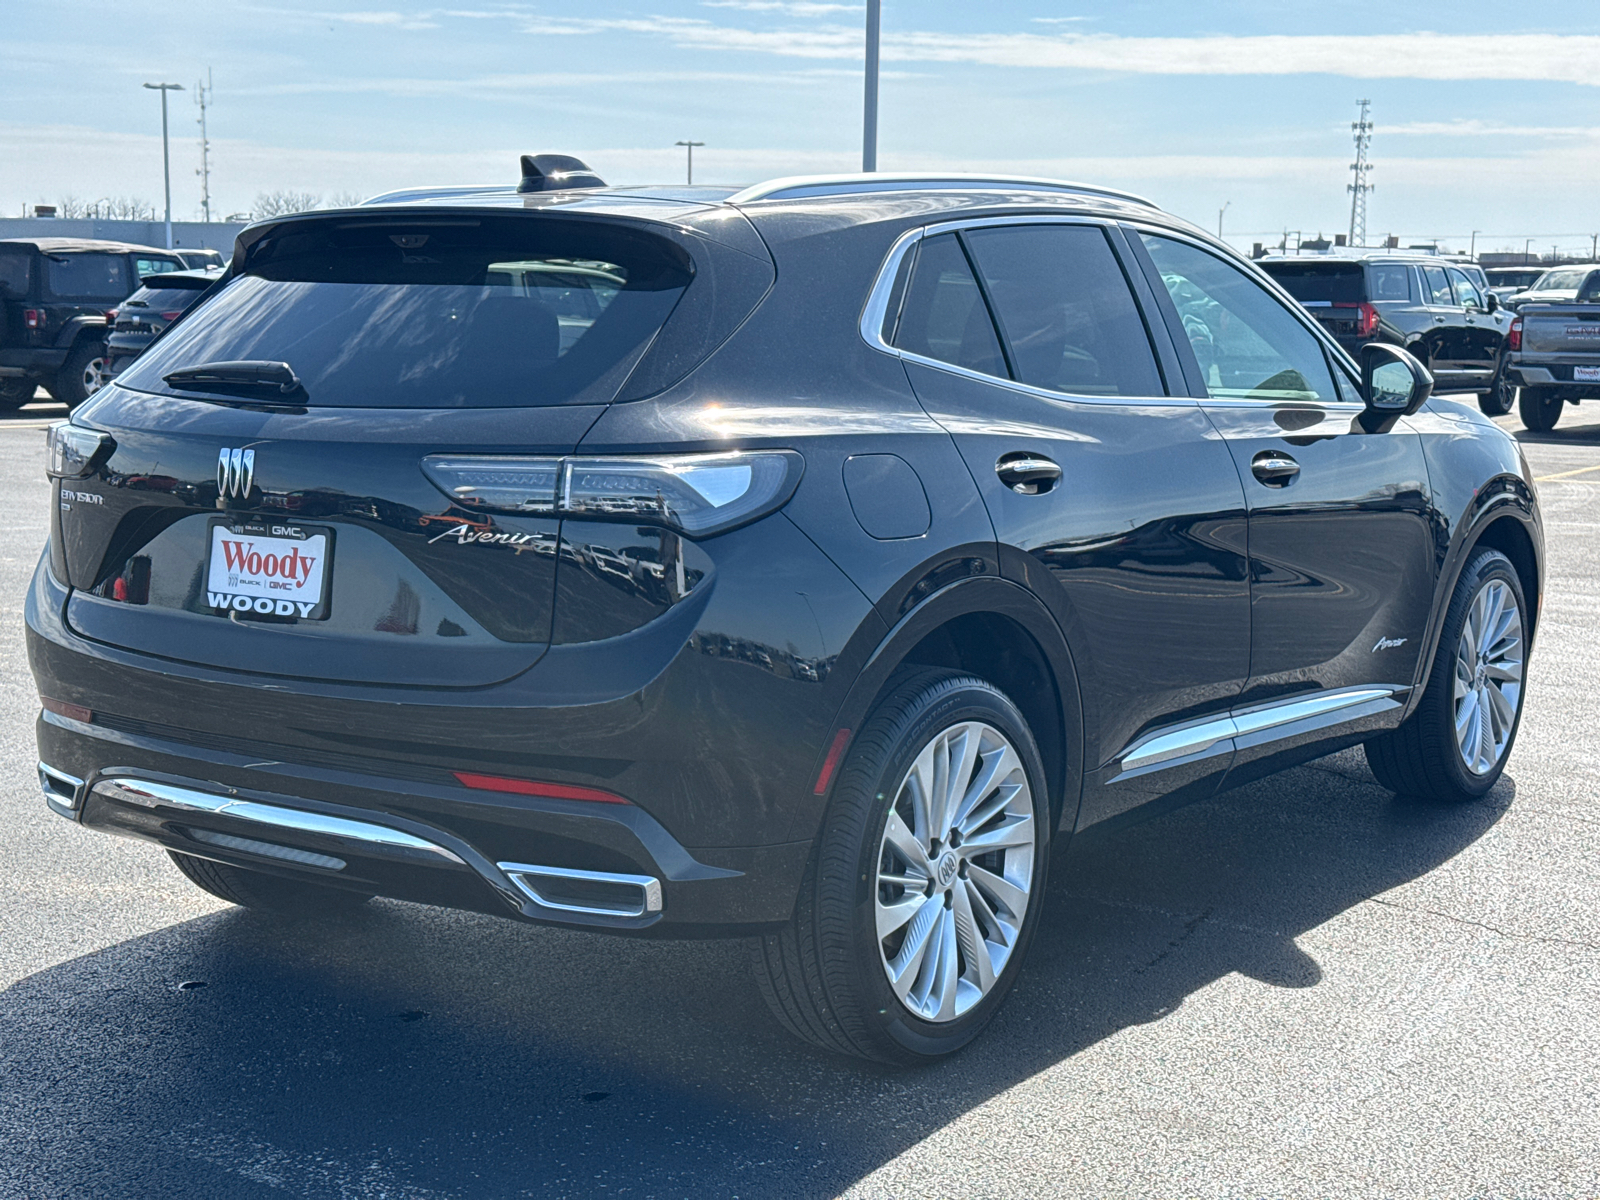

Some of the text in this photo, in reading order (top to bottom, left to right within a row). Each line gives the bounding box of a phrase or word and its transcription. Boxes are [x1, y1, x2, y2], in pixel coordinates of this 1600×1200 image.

[1566, 326, 1600, 335] GM
[272, 525, 302, 537] GMC
[427, 523, 543, 545] Avenir
[221, 540, 316, 588] Woody
[269, 580, 293, 591] GMC
[207, 592, 316, 618] WOODY
